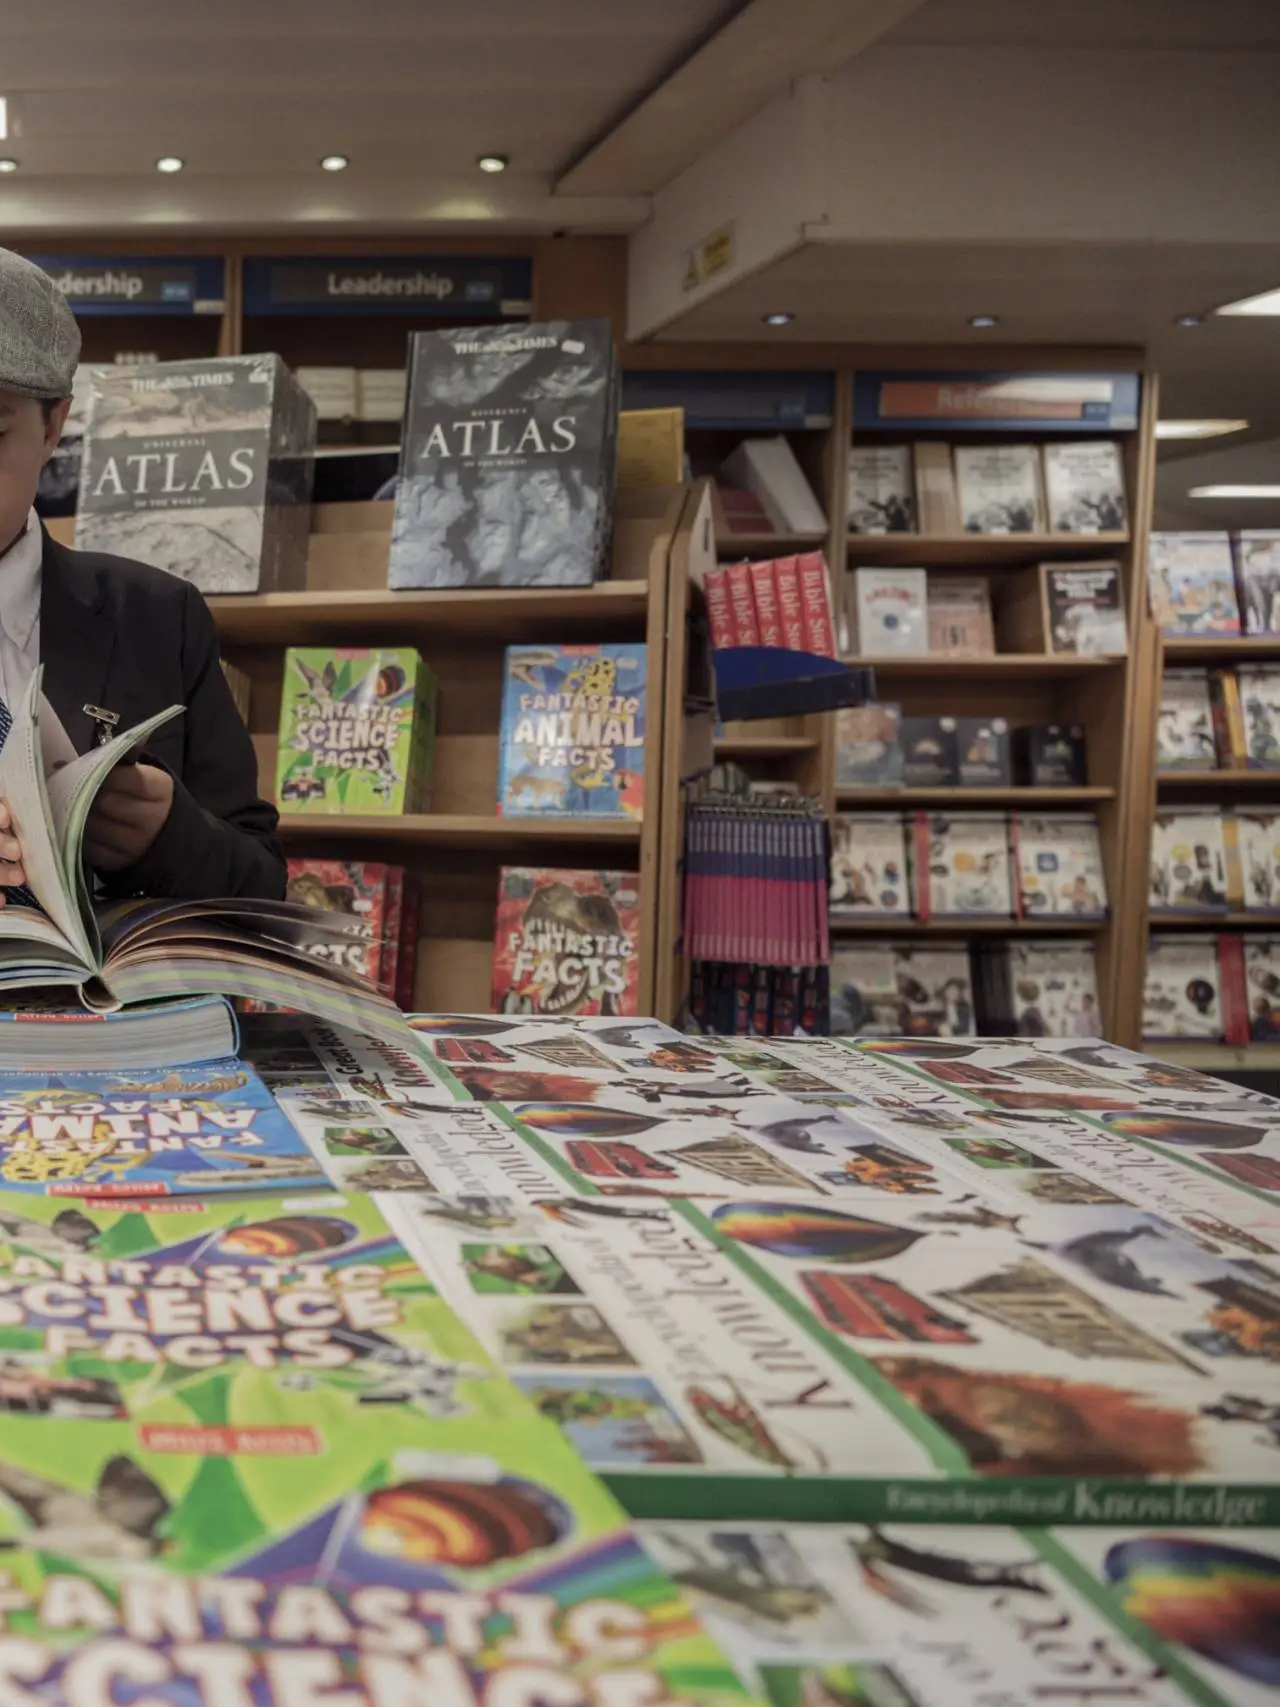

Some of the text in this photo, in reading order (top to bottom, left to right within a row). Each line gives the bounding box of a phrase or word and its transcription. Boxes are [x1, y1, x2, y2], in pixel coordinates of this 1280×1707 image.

[55, 271, 143, 299] dership
[328, 272, 453, 300] Leadership
[419, 416, 576, 458] ATLAS
[92, 448, 255, 496] ATLAS
[731, 581, 754, 625] Bible
[755, 579, 776, 619] Bible
[779, 575, 801, 617] Bible
[803, 571, 825, 613] Bible
[296, 701, 405, 722] FANTASTIC
[519, 692, 640, 714] FANTASTIC
[293, 719, 400, 752] SCIENCE
[514, 711, 644, 747] ANIMAL
[312, 748, 380, 771] FACTS
[538, 746, 616, 771] FACTS
[310, 944, 366, 975] CTS
[508, 931, 635, 957] FANTASTIC
[512, 950, 627, 994] FACTS
[354, 1033, 435, 1088] Knowled
[448, 1112, 561, 1197] nowledge
[627, 1217, 853, 1409] Knowledge
[45, 1326, 358, 1368] FACTS
[1073, 1481, 1265, 1523] Knowledge
